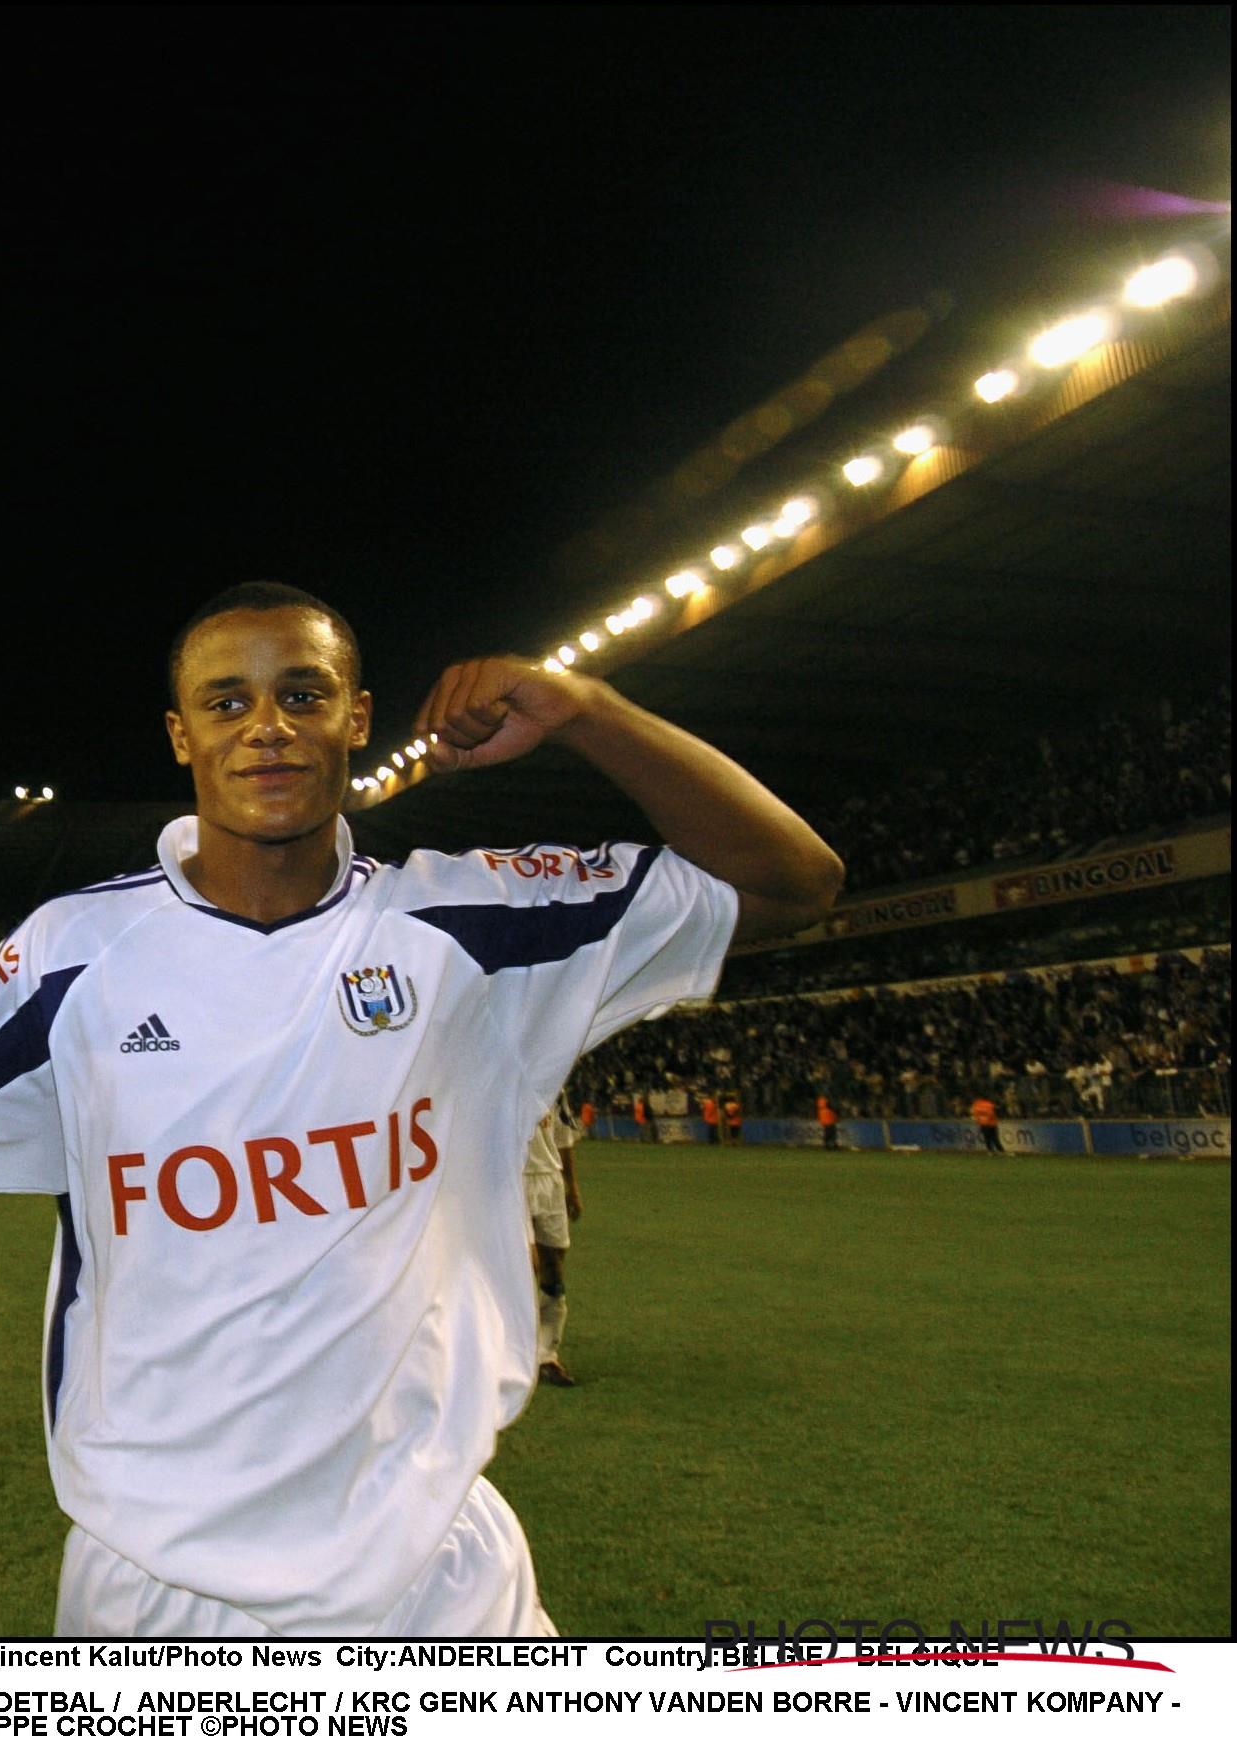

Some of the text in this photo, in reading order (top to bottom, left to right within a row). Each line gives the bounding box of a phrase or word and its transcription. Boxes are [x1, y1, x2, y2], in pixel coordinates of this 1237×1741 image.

[1033, 848, 1173, 897] BINGOAL
[120, 1038, 181, 1054] adidas
[107, 1097, 439, 1237] FORTIS
